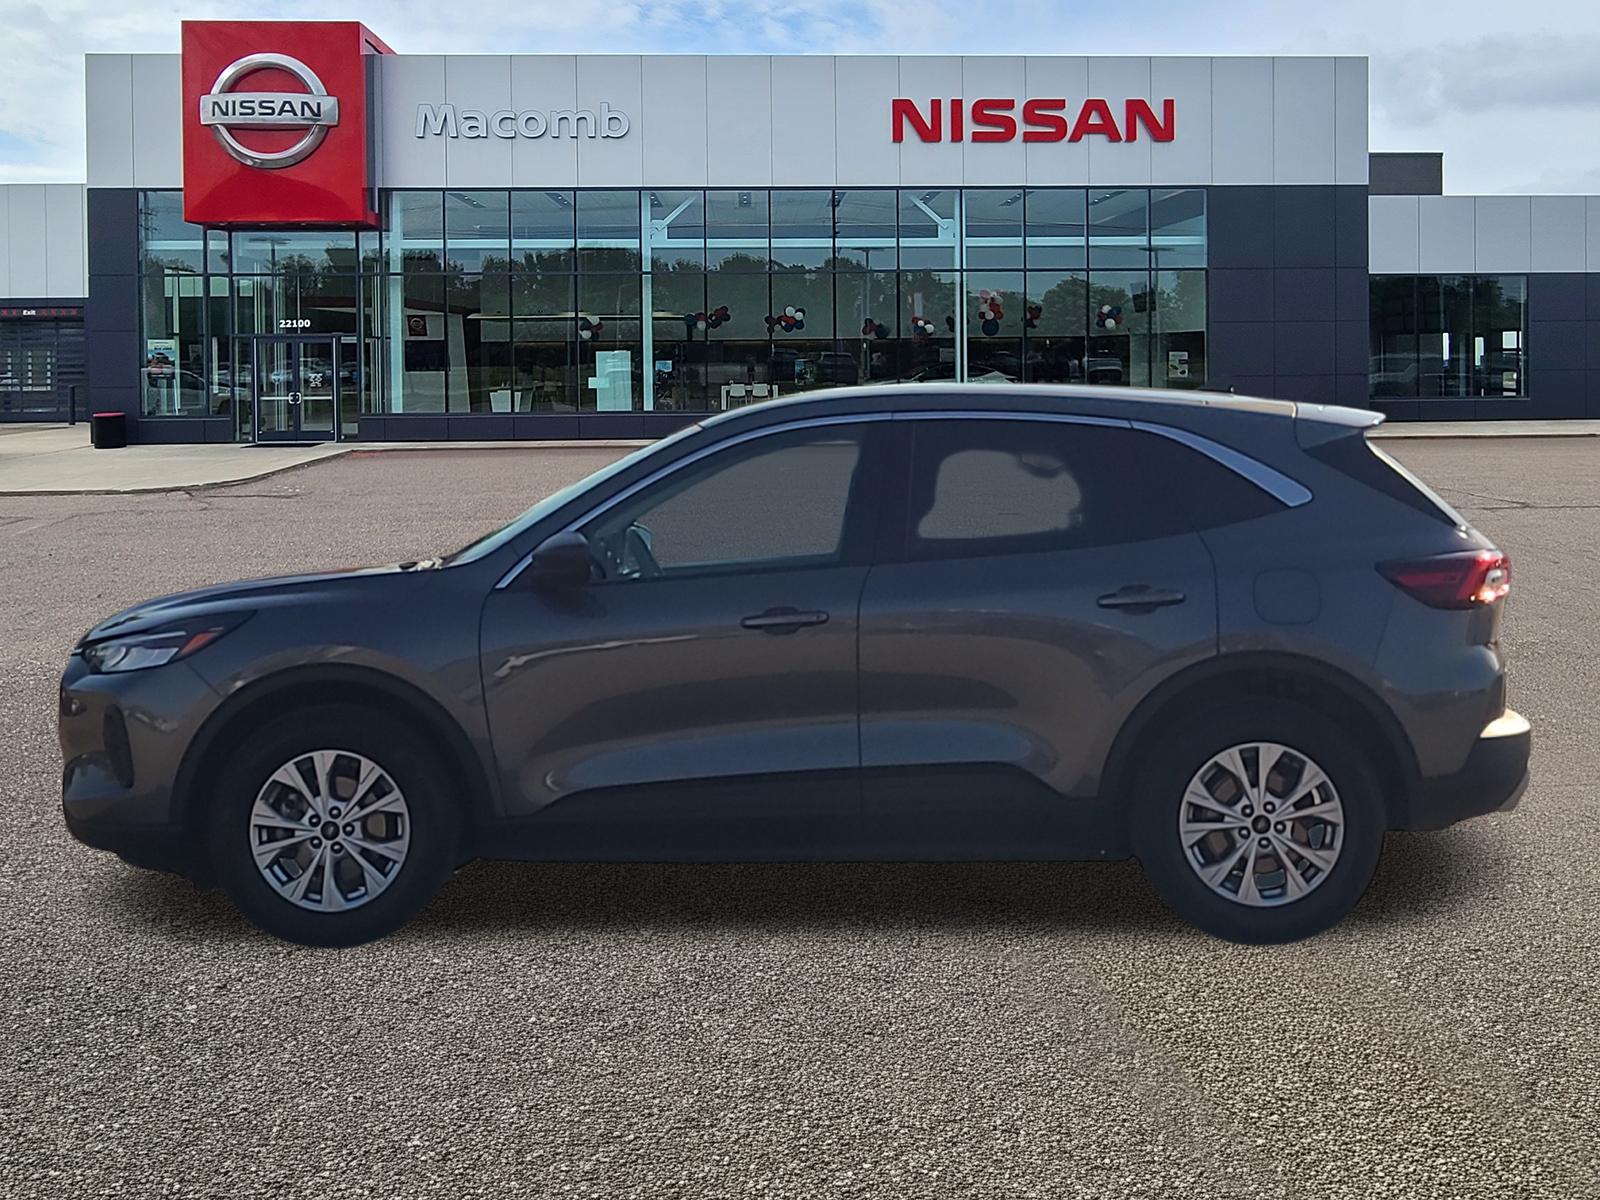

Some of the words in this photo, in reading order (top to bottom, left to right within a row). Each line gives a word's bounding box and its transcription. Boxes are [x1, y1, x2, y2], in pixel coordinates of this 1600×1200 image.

[212, 100, 322, 117] NISSAN
[415, 102, 629, 138] Macomb
[892, 98, 1175, 142] NISSAN
[279, 319, 311, 328] 22100
